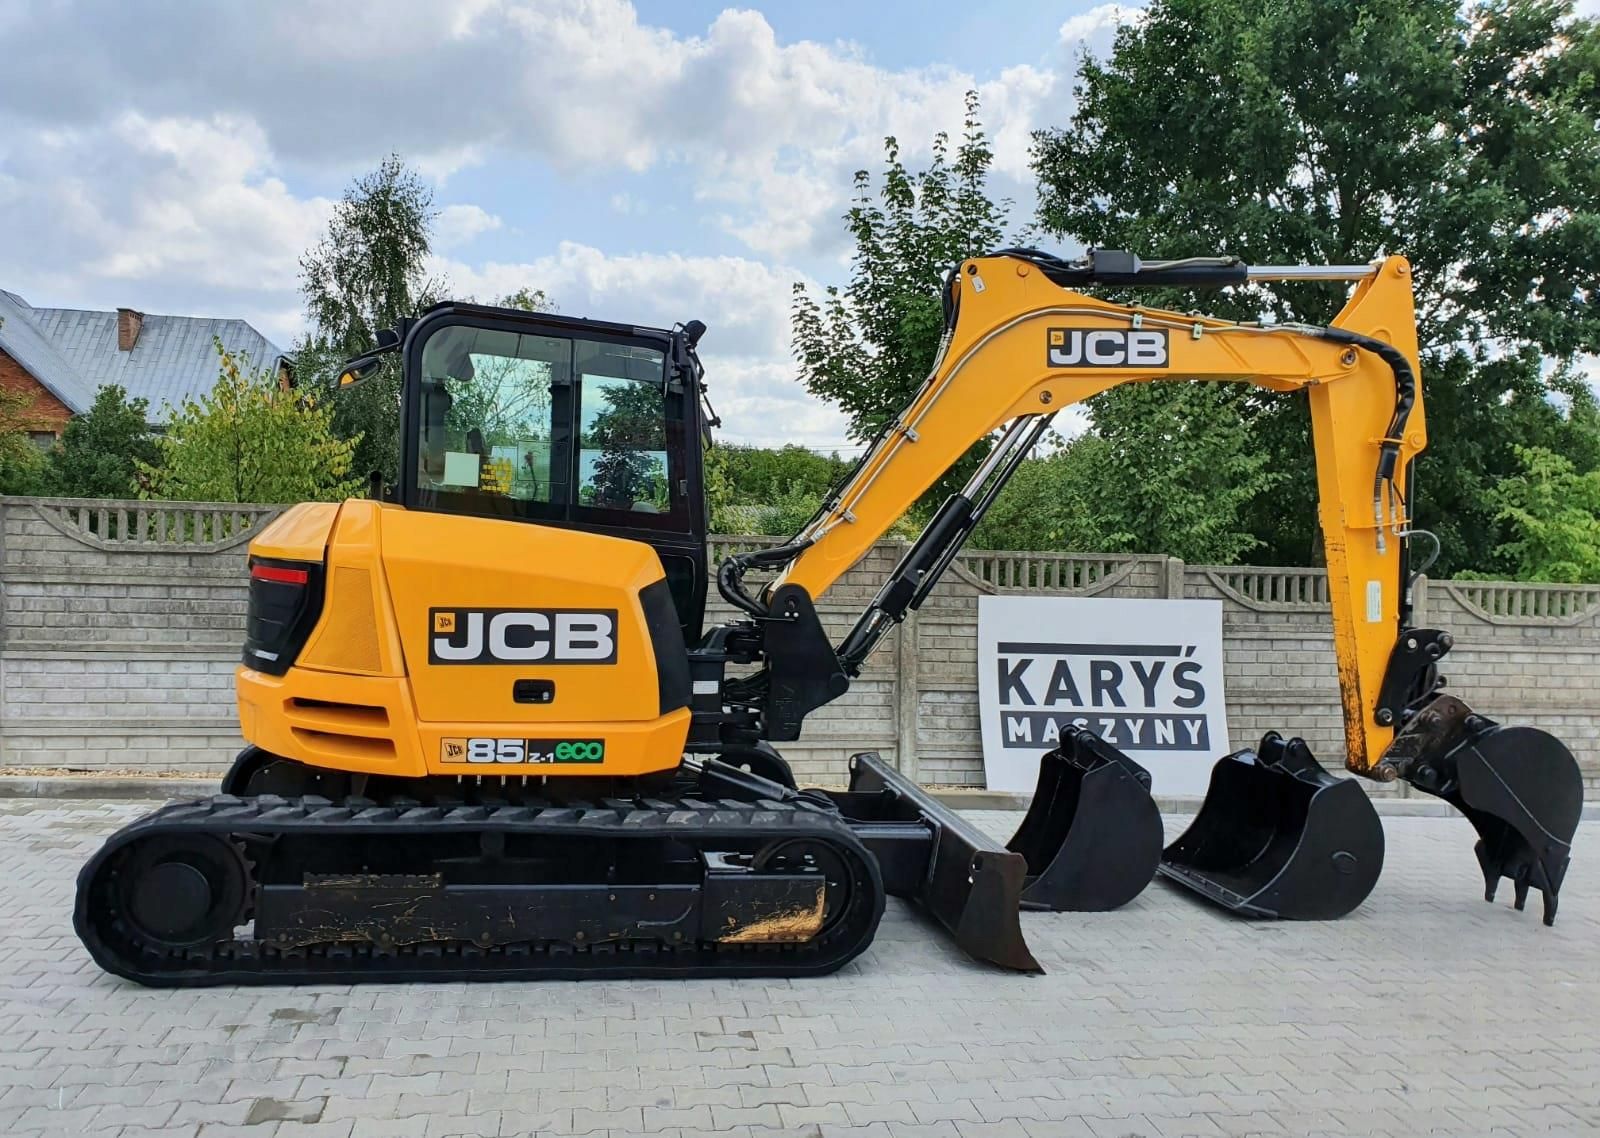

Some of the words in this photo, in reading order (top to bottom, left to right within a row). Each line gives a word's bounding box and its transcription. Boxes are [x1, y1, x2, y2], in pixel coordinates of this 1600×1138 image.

[1050, 330, 1166, 365] JCB
[434, 612, 613, 660] JCB
[997, 645, 1206, 709] KARYŚ
[467, 738, 525, 763] 85
[528, 752, 554, 763] Z-1
[555, 742, 603, 760] eco
